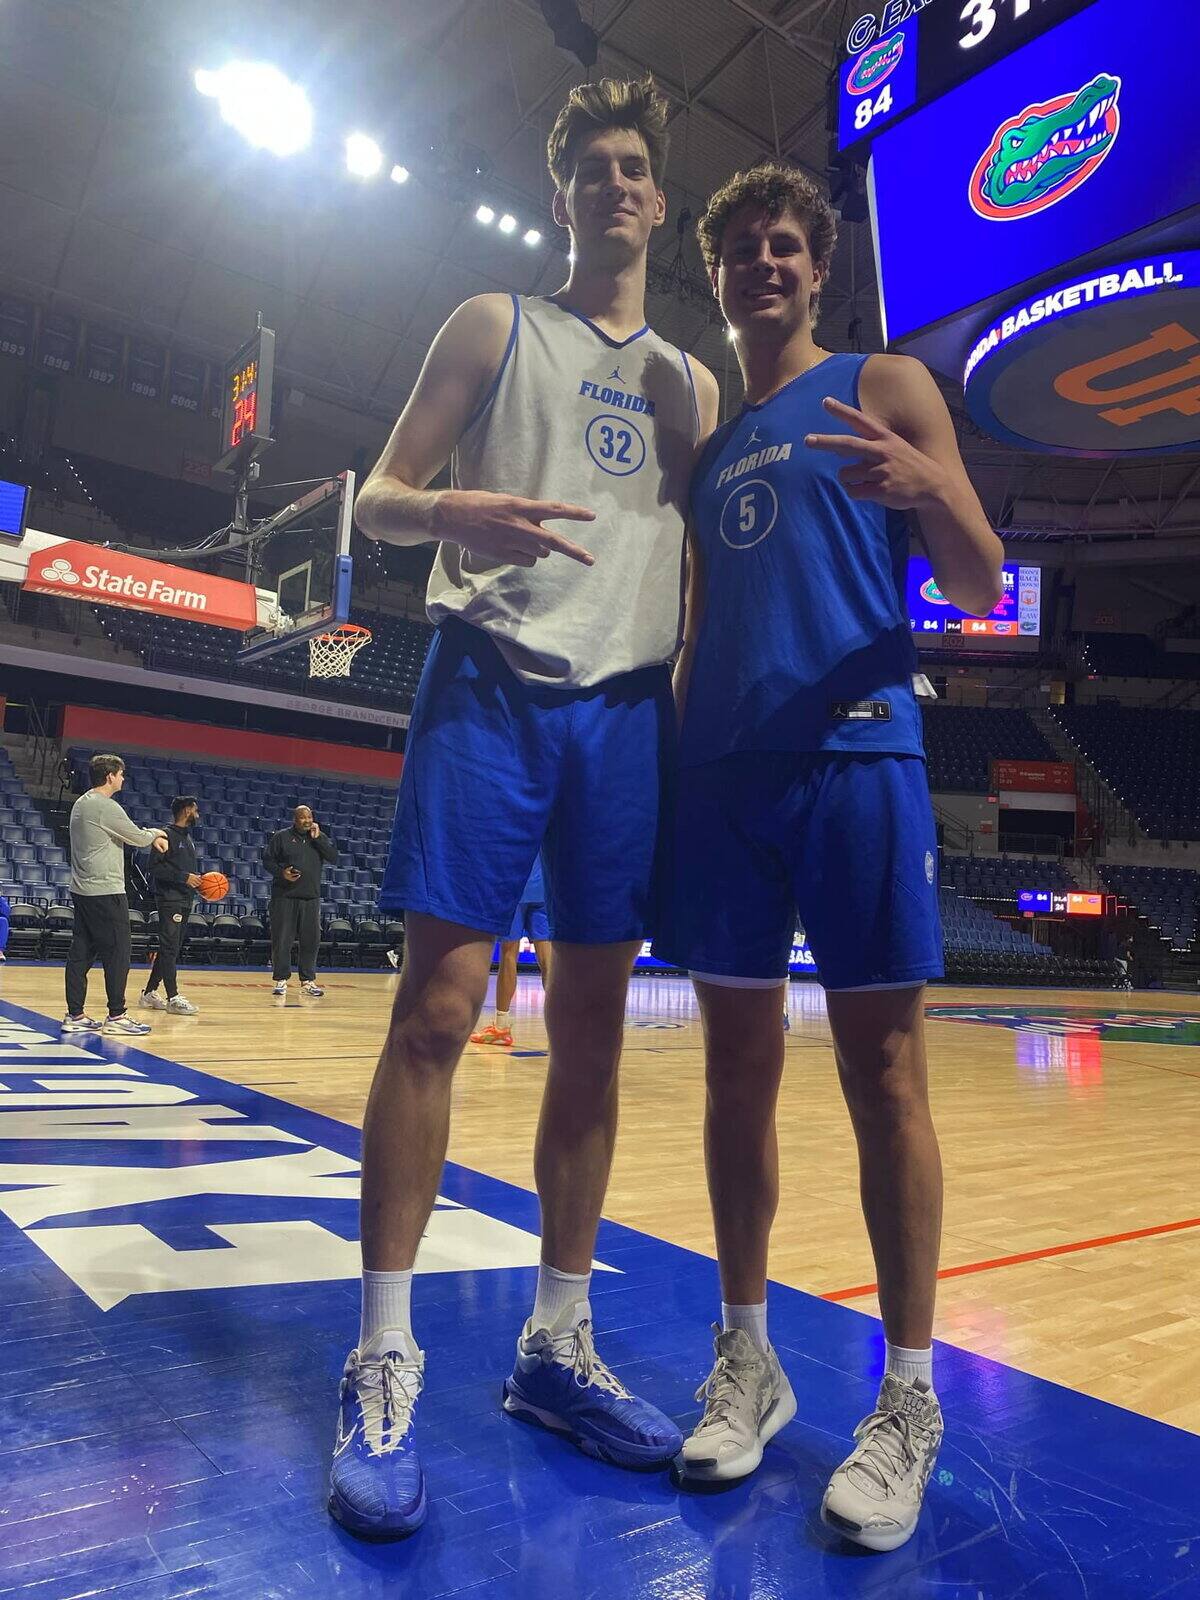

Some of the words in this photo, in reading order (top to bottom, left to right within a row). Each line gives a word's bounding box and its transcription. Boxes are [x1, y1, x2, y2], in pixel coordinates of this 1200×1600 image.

[855, 84, 893, 130] 84
[1001, 262, 1183, 340] BASKETBALL
[578, 380, 656, 417] FLORIDA
[231, 392, 256, 447] 24
[599, 425, 632, 464] 32
[716, 443, 793, 490] FLORIDA
[739, 494, 756, 532] 5
[923, 620, 938, 630] 84
[879, 706, 884, 715] L
